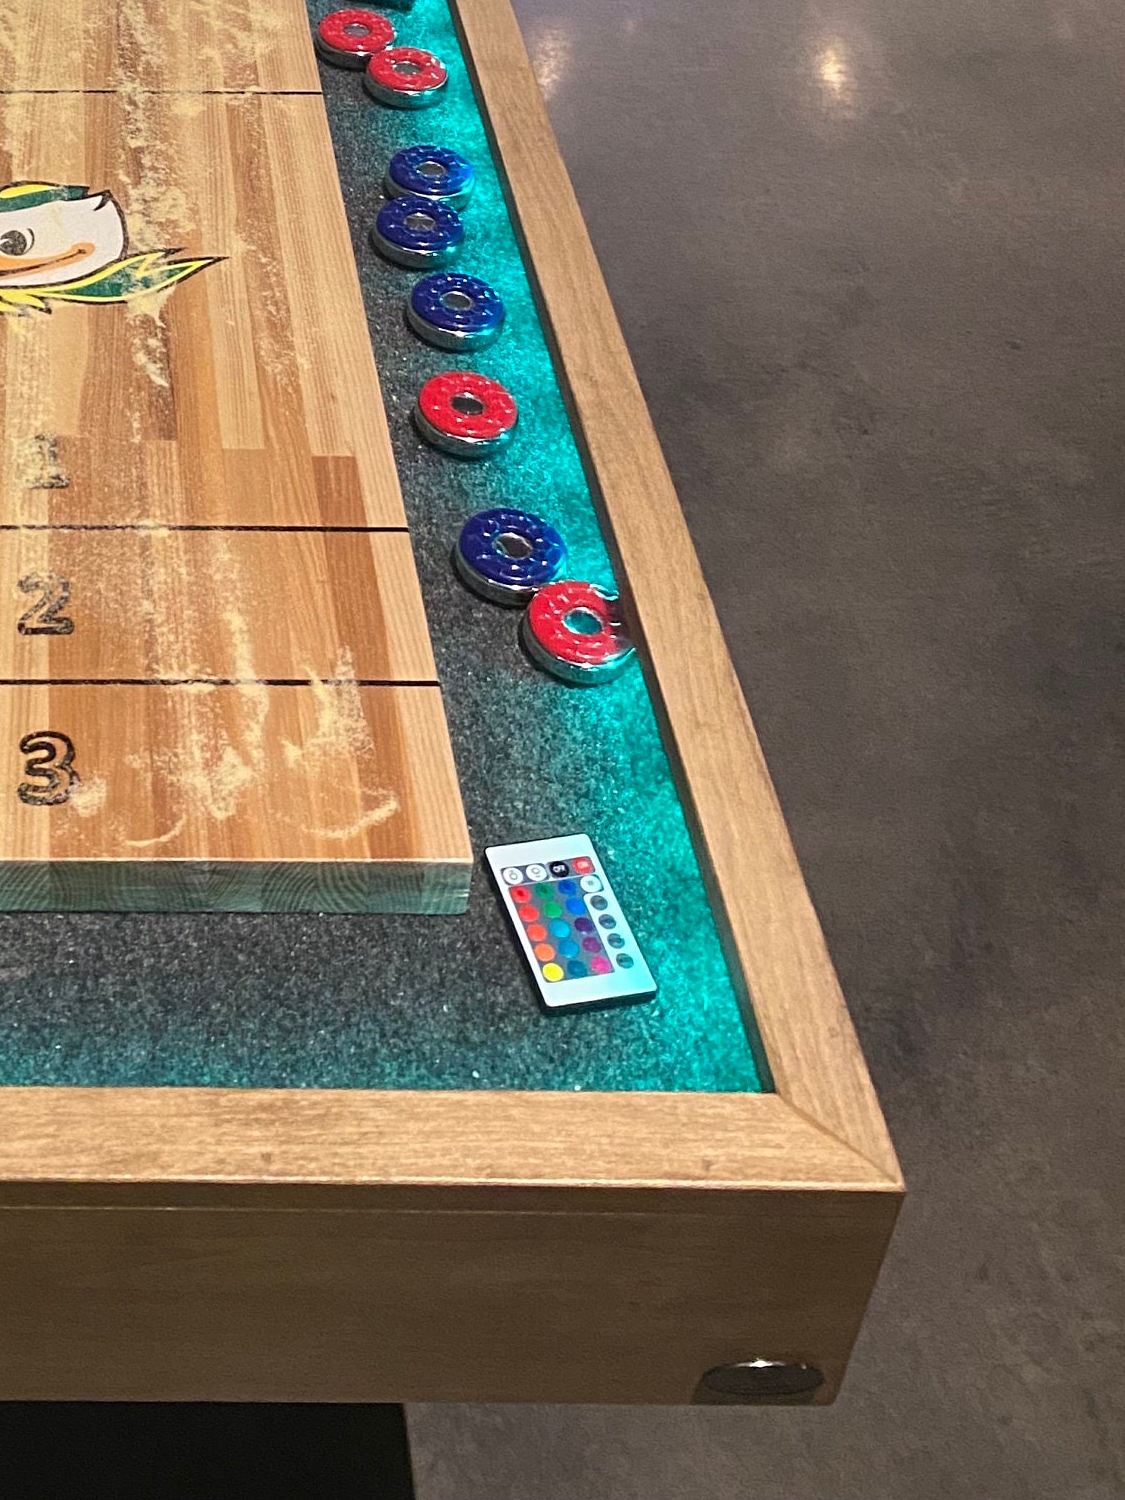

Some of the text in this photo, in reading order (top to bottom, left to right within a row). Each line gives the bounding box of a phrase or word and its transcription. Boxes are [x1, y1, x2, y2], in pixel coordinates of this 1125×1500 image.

[25, 433, 71, 489] 1
[17, 572, 75, 636] 2
[17, 730, 80, 806] 3
